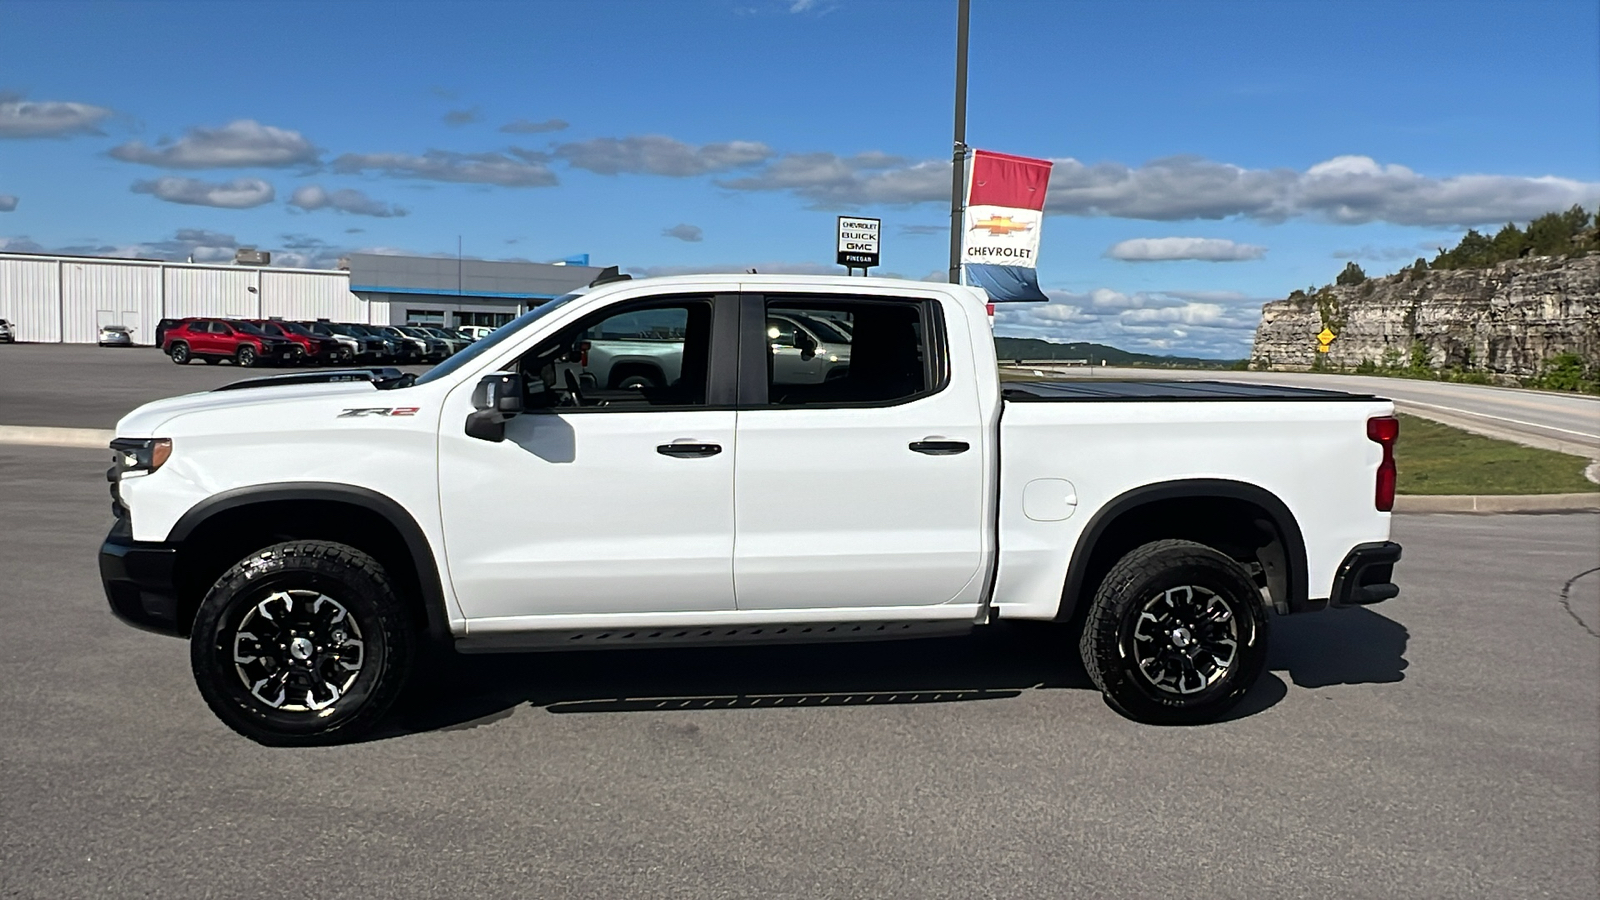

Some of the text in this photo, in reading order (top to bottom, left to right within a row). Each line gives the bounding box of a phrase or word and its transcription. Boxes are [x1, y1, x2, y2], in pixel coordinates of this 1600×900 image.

[842, 221, 877, 230] CHEVROLET
[841, 232, 876, 240] BUICK
[846, 242, 872, 251] GMC
[967, 246, 1032, 258] CHEVROLET
[336, 407, 421, 418] ZR2
